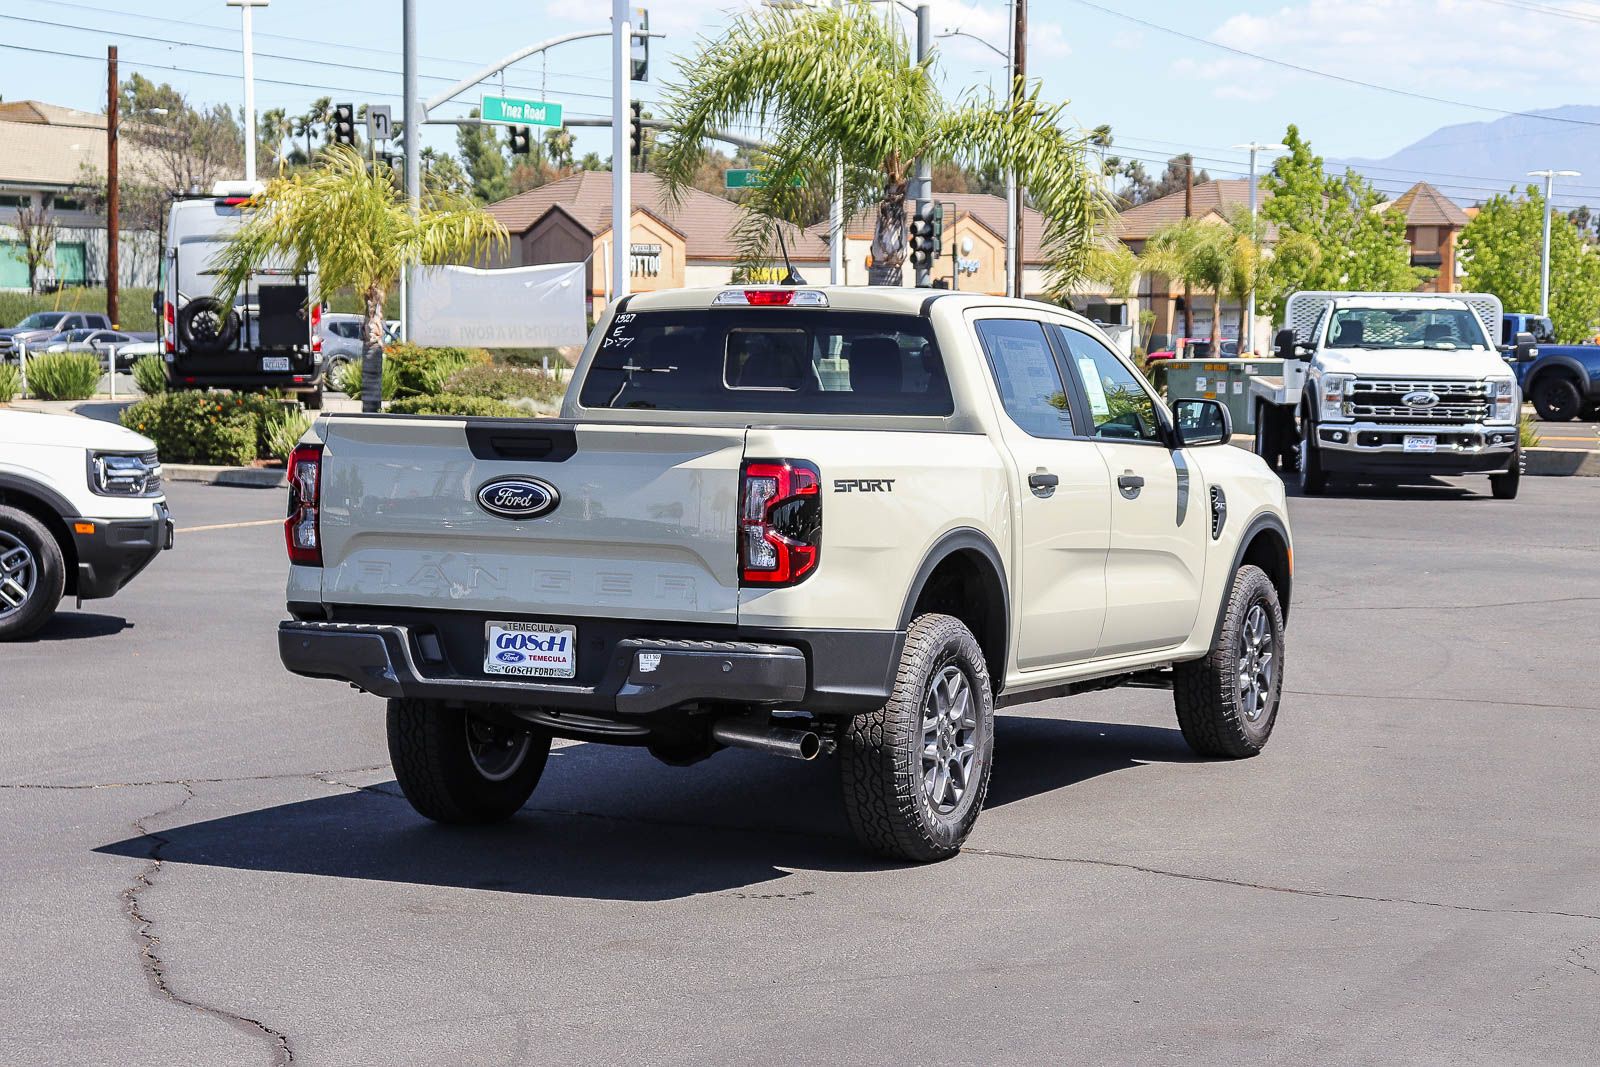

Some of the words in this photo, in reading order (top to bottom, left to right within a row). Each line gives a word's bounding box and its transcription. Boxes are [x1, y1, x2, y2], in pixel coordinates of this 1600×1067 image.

[501, 101, 522, 118] Ynez
[524, 104, 546, 121] Road
[631, 255, 661, 274] ATTOO
[615, 314, 637, 323] 1527
[613, 326, 626, 337] E
[834, 479, 896, 493] SPORT
[494, 487, 533, 507] Ford
[358, 558, 698, 607] RANGER
[508, 622, 555, 633] TEMECULA
[502, 652, 519, 662] Ford
[528, 654, 567, 663] TEMECULA
[533, 667, 554, 676] FORD
